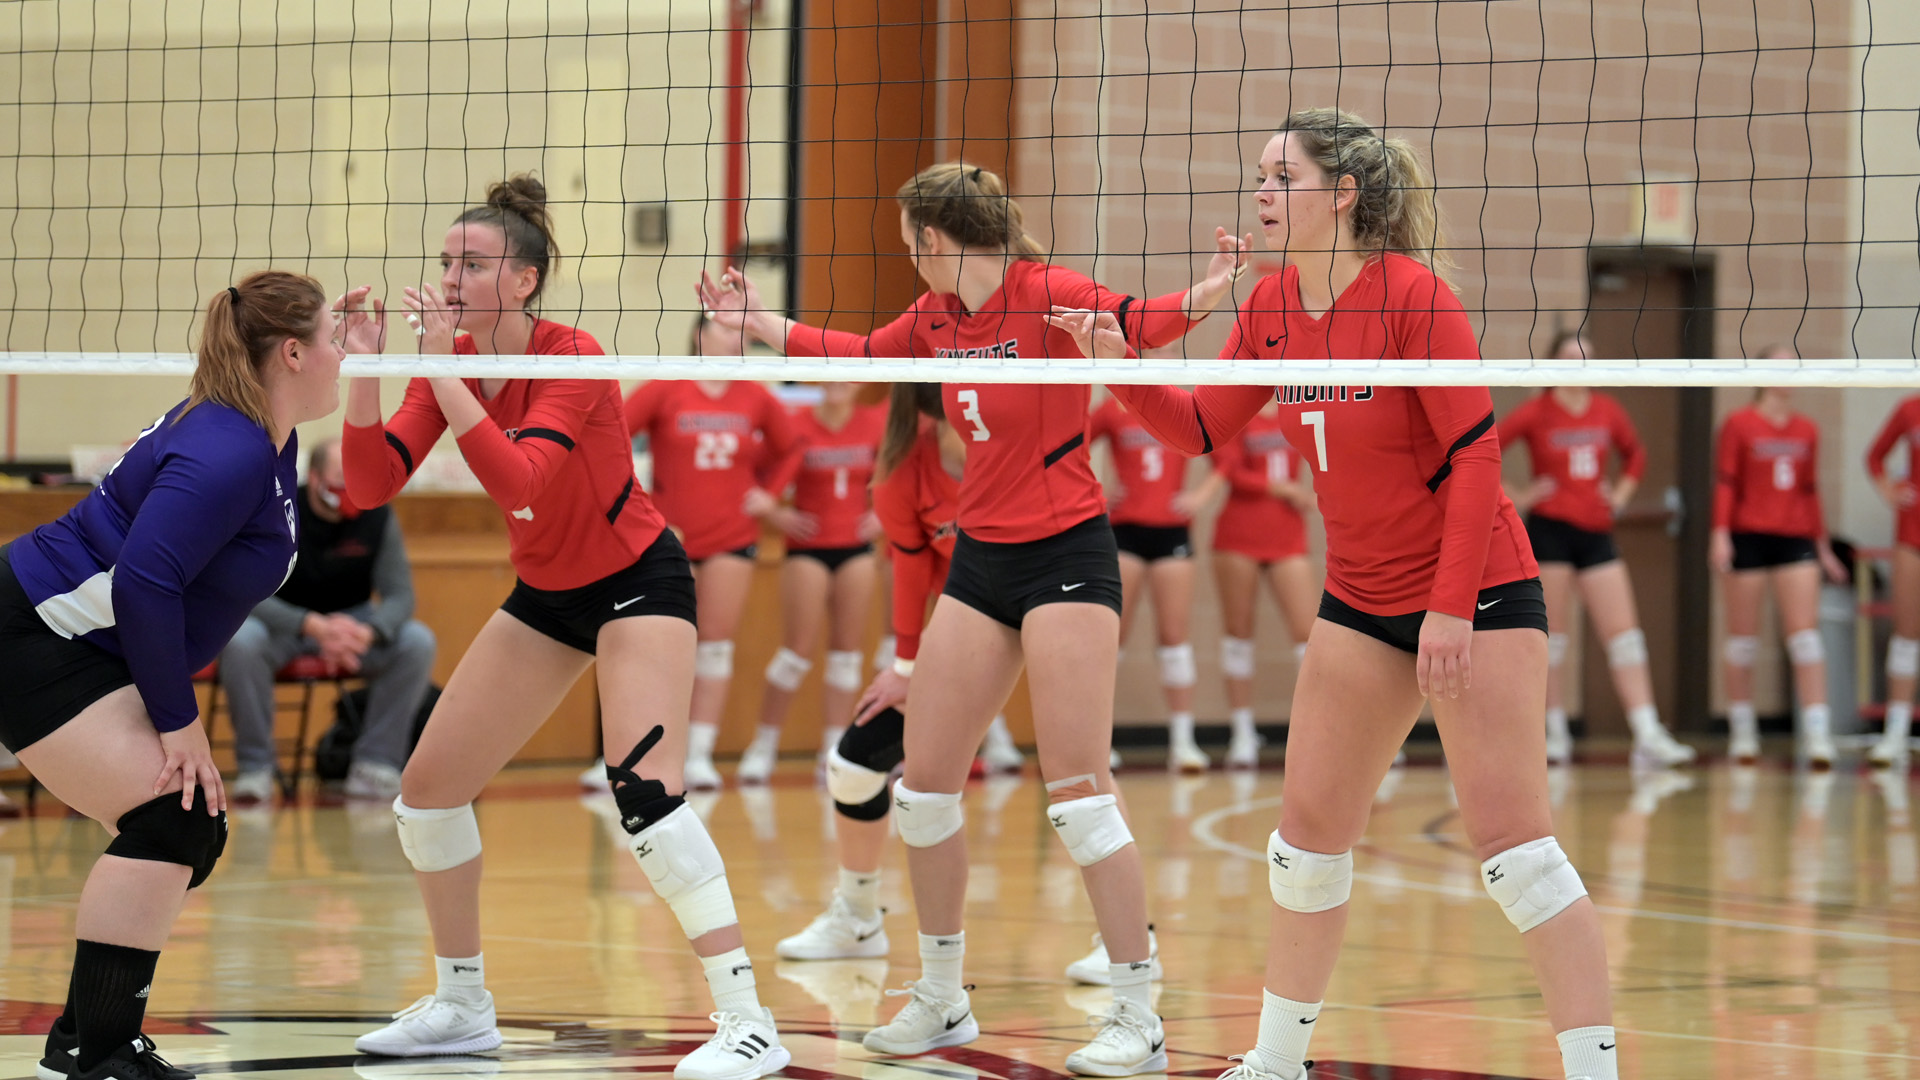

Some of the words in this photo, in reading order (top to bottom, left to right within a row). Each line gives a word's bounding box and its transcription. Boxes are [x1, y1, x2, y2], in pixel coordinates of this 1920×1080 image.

[957, 389, 991, 442] 3
[1301, 410, 1328, 472] 7
[694, 432, 739, 470] 22
